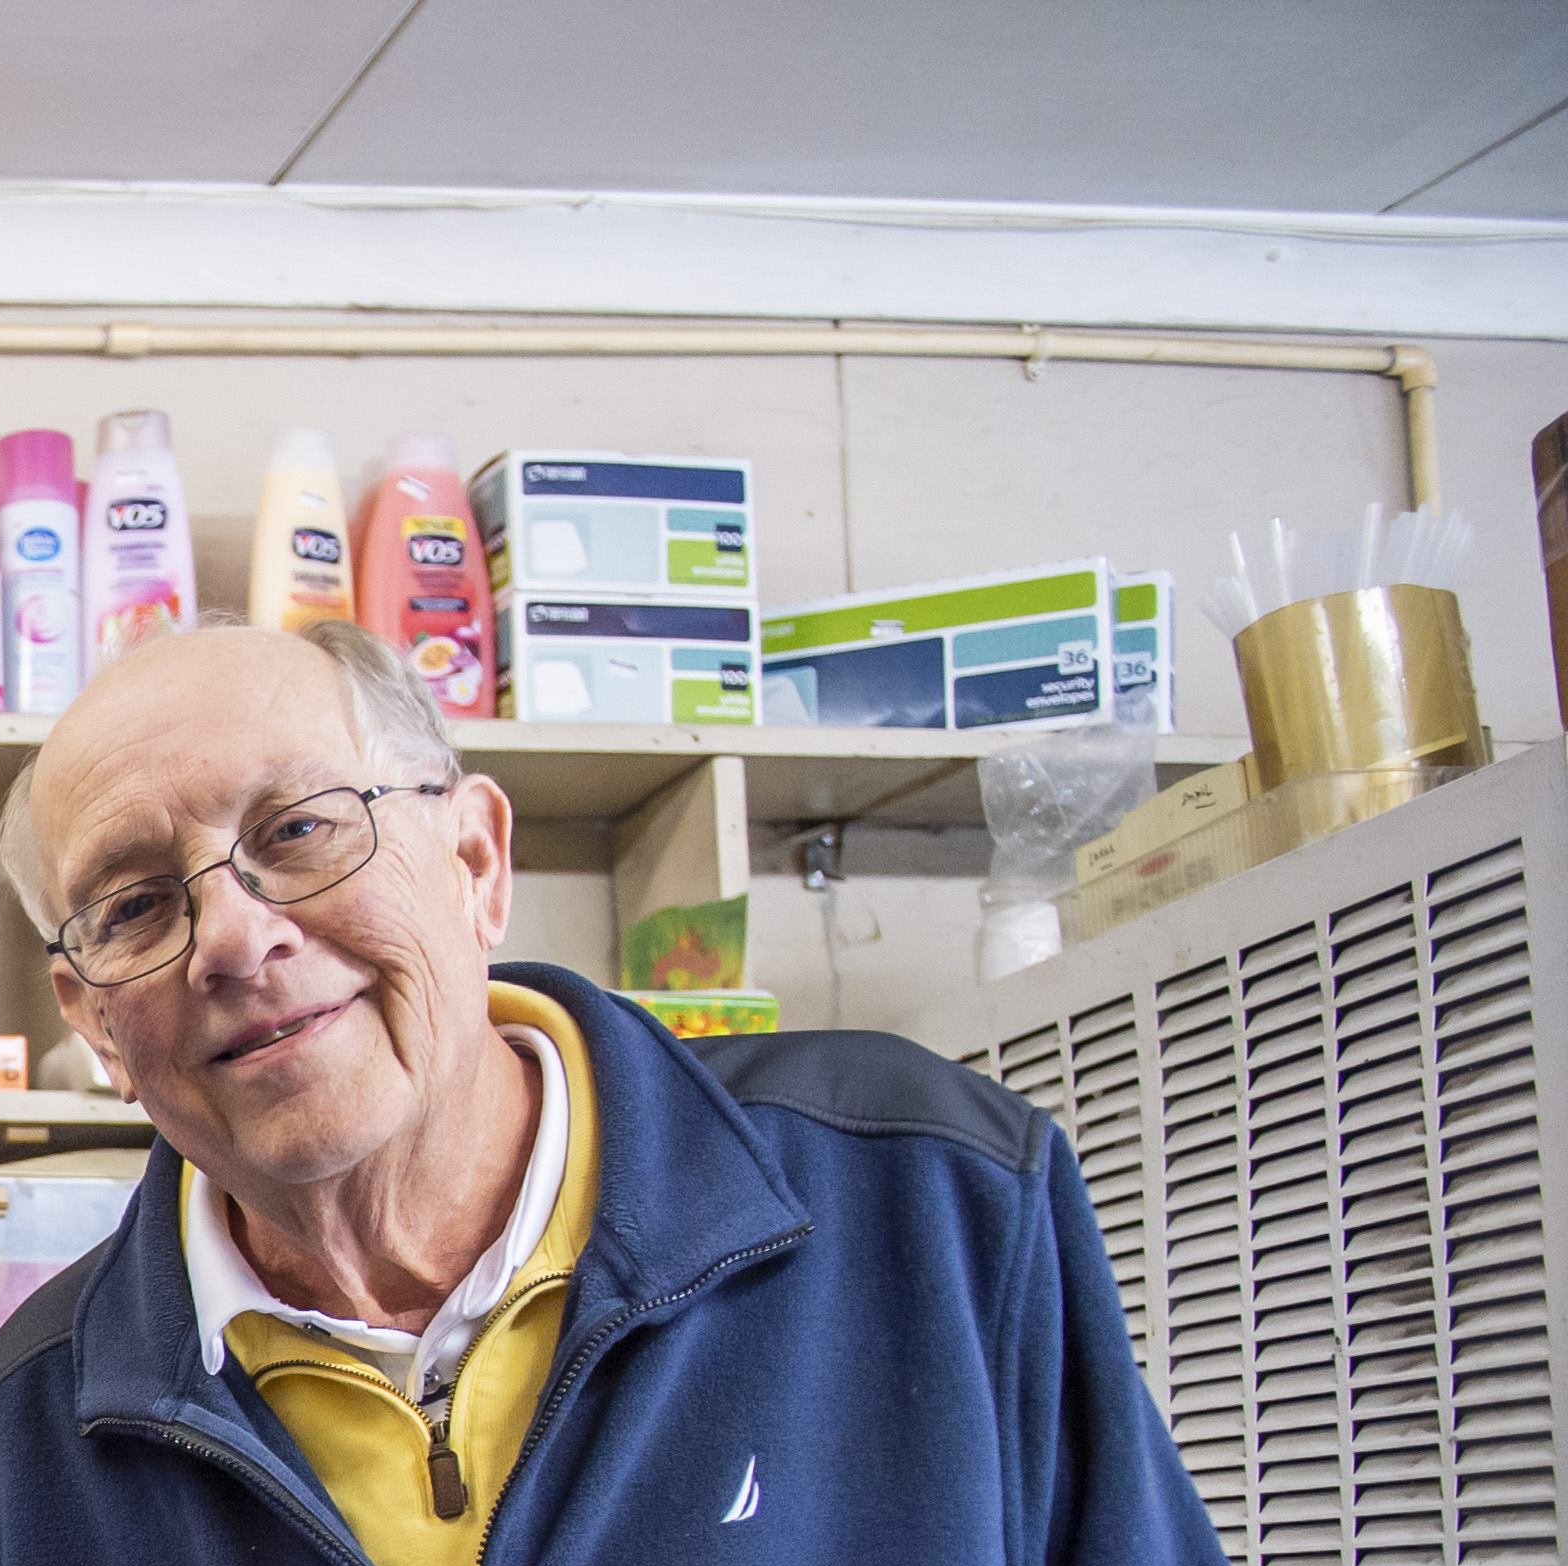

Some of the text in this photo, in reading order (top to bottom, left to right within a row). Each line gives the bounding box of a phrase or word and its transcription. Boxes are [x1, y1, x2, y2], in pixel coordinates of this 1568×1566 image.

[1064, 649, 1089, 667] 36
[1121, 661, 1147, 678] 36
[1025, 689, 1096, 711] envelopes
